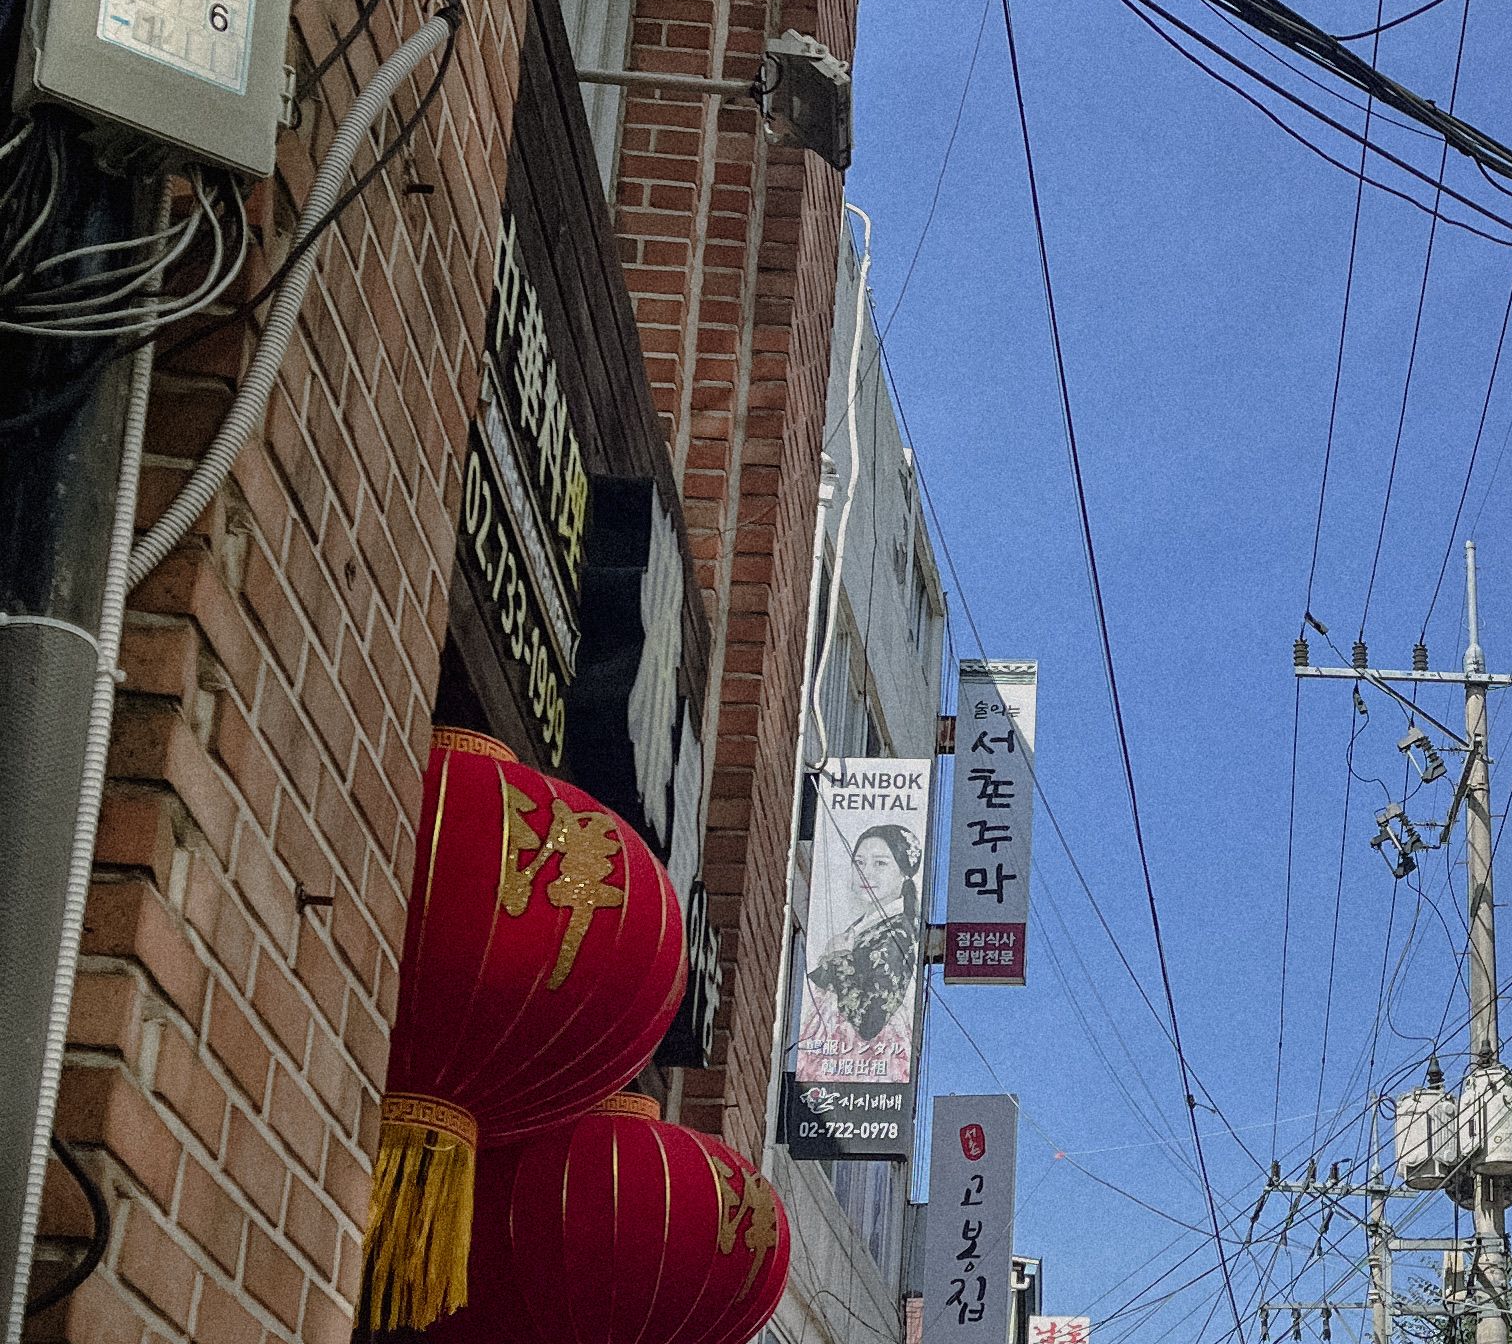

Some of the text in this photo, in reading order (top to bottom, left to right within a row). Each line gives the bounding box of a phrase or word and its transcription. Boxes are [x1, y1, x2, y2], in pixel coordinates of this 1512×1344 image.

[464, 449, 566, 769] 02.733-1999
[831, 772, 923, 790] HANBOK
[831, 793, 918, 811] RENTAL
[964, 729, 1017, 904] 서촌주막
[956, 931, 1016, 948] 점심식사
[799, 1121, 899, 1139] 02-722-0978
